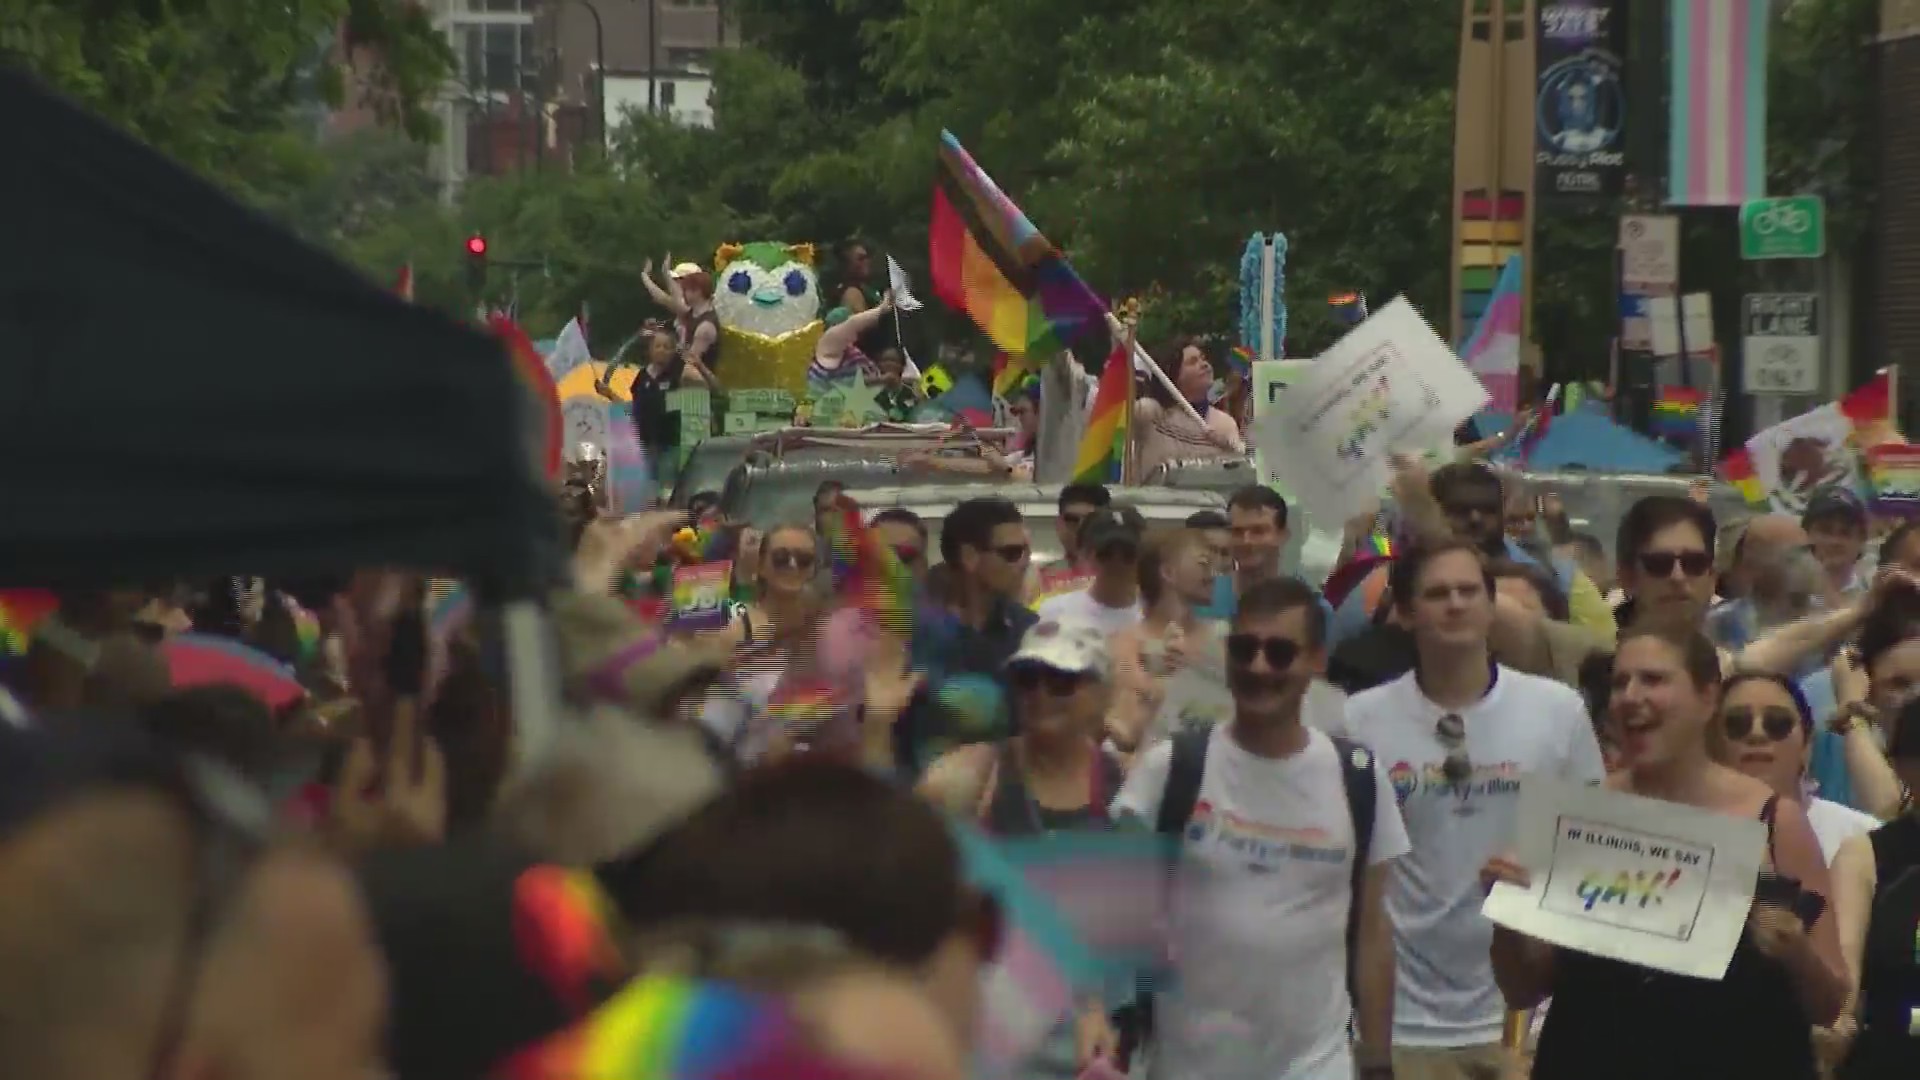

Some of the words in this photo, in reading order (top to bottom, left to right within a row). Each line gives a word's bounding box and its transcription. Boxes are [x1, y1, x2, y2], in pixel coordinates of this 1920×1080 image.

[1567, 828, 1583, 841] IN
[1585, 832, 1645, 857] ILLINOIS,
[1650, 845, 1671, 859] WE
[1675, 851, 1701, 865] SAY
[1576, 868, 1682, 912] GAY!
